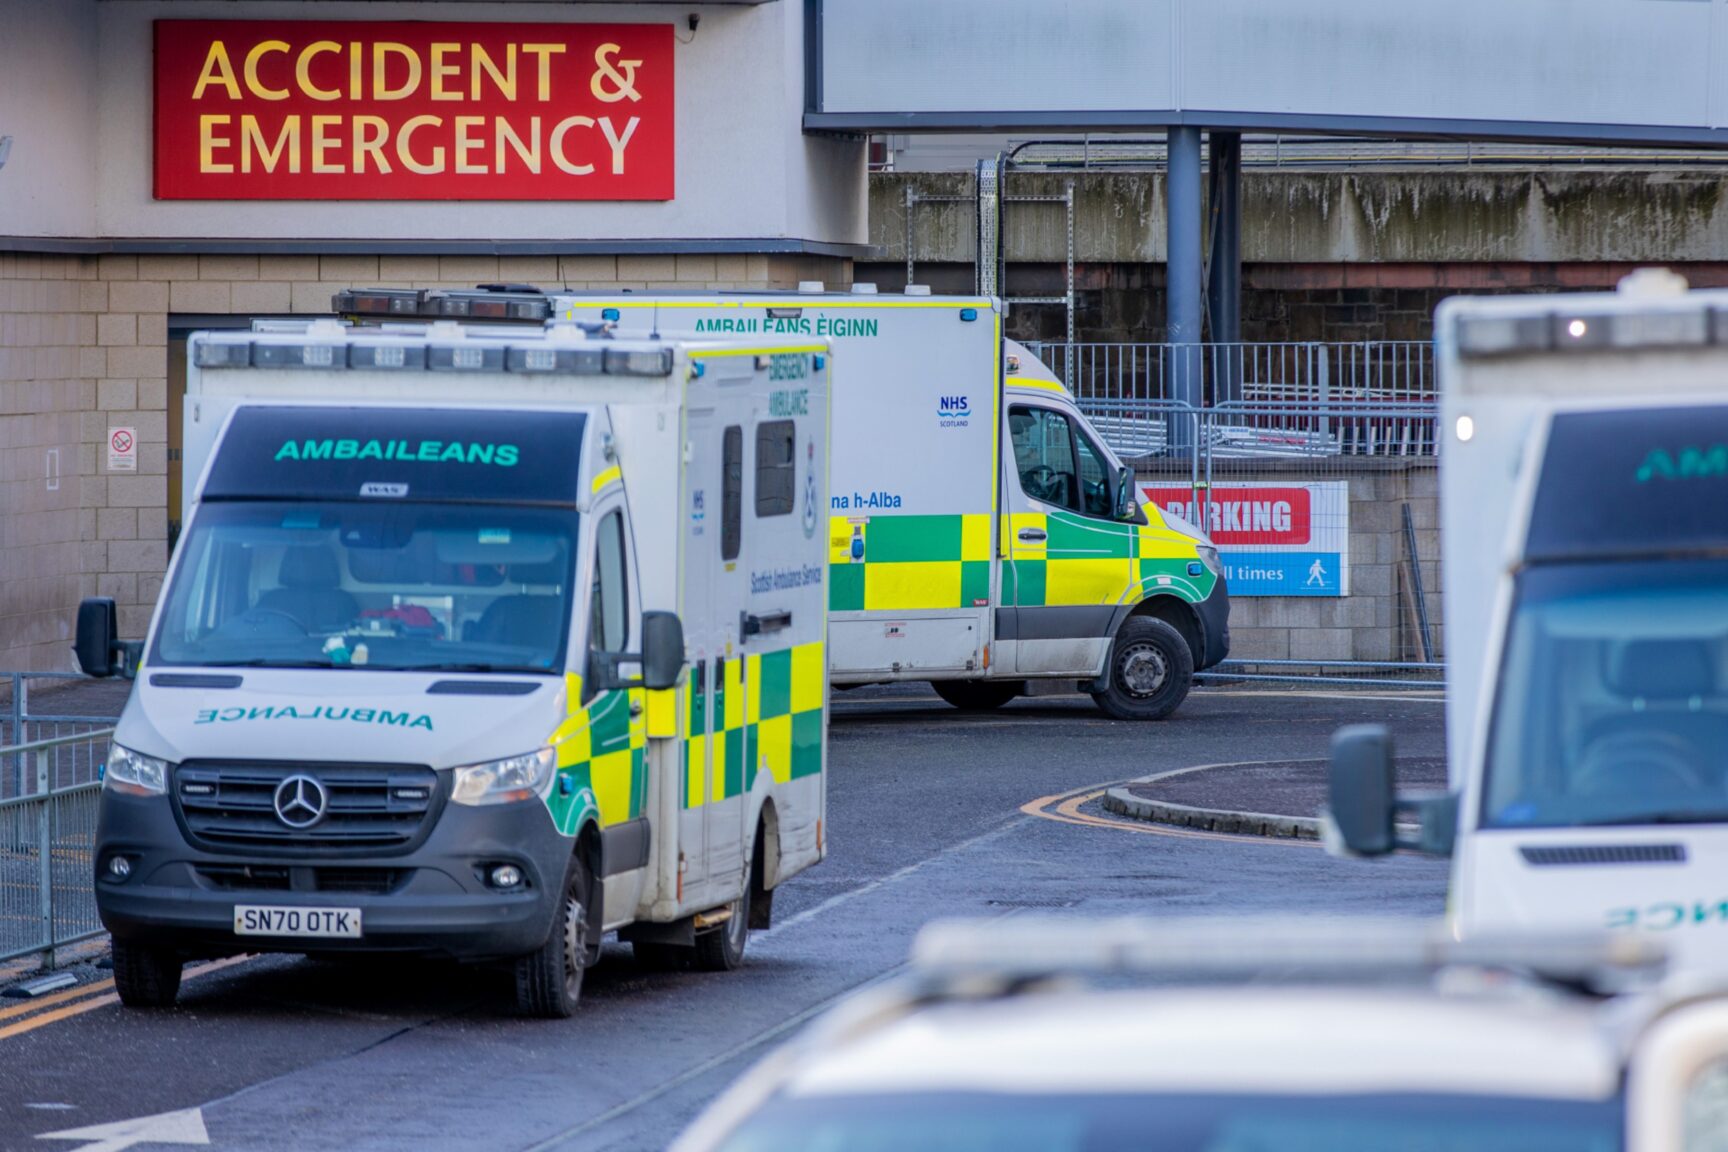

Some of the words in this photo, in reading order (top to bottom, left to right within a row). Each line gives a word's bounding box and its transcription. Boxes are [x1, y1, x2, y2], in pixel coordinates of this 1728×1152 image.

[192, 40, 566, 102] ACCIDENT
[590, 43, 643, 103] &
[199, 114, 641, 176] EMERGENCY
[816, 312, 878, 337] ÈIGINN
[940, 396, 968, 410] NHS
[939, 420, 969, 428] SCOTLAND
[274, 439, 520, 467] AMBAILEANS
[831, 496, 849, 509] na
[854, 491, 902, 509] h-Alba
[1238, 565, 1284, 580] times
[245, 909, 300, 931] SN70
[306, 911, 349, 932] OTK
